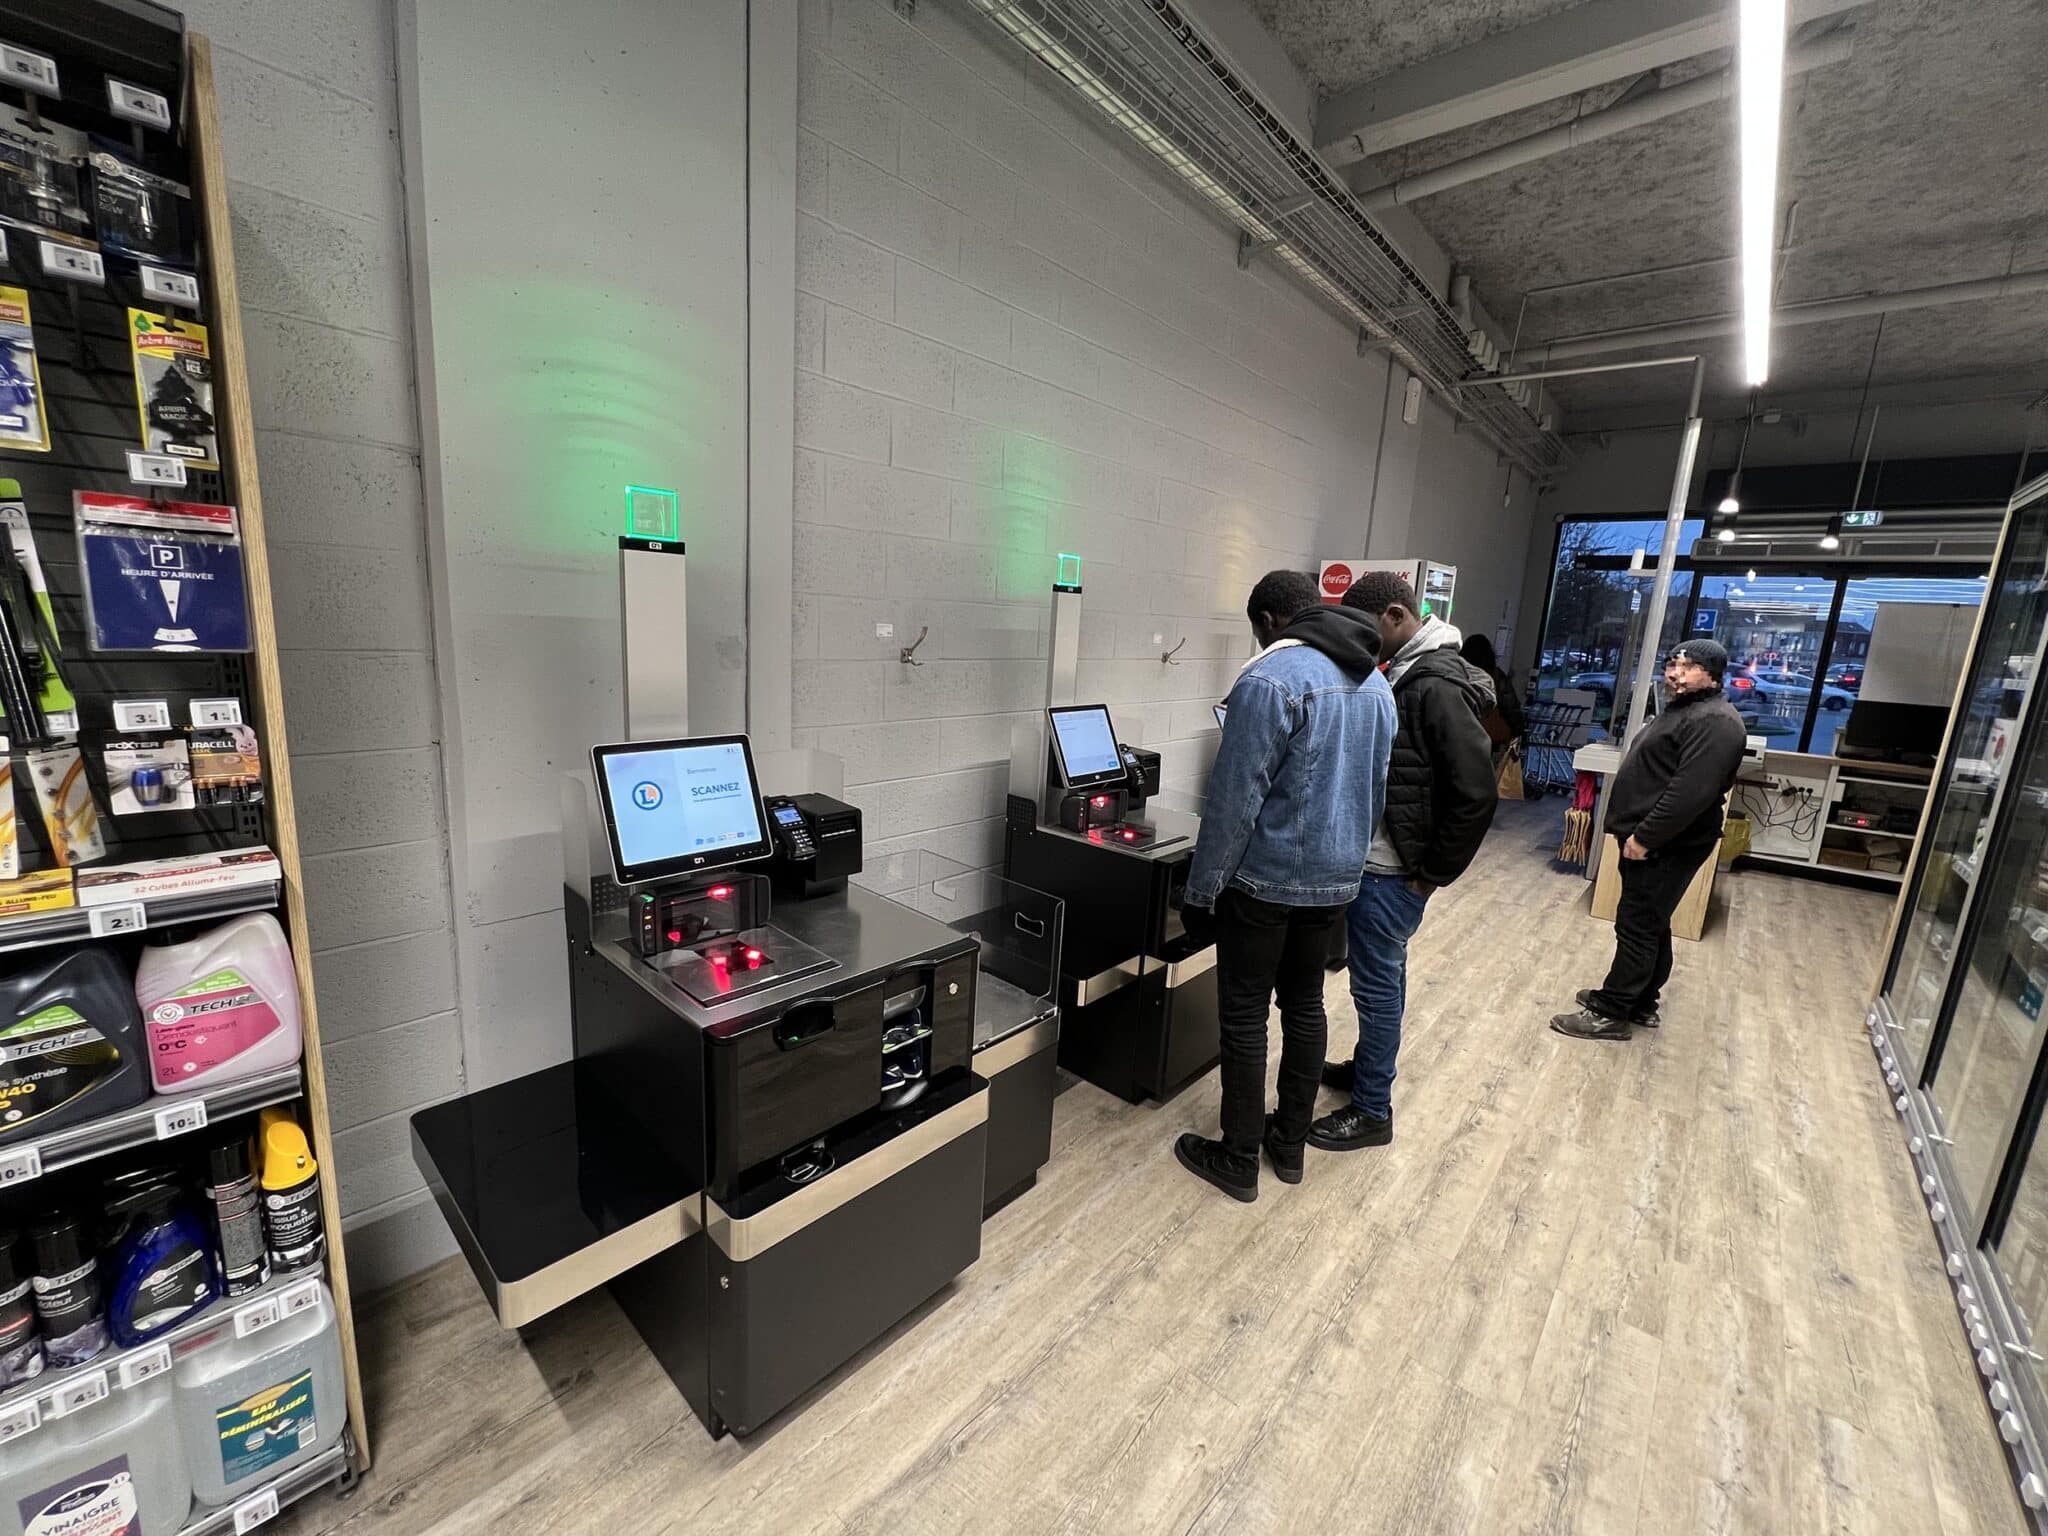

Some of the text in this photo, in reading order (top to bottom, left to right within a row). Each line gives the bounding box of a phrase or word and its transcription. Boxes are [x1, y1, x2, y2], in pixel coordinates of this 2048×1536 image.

[159, 549, 175, 564] P
[121, 568, 158, 578] HEURE
[1323, 573, 1351, 584] Coca-Cola
[135, 714, 147, 724] 3
[209, 712, 220, 721] 1
[105, 740, 160, 750] FOXTER
[188, 740, 235, 750] URACELL
[691, 781, 741, 796] SCANNEZ
[149, 881, 179, 893] Cubes
[180, 873, 237, 888] Allume-feu
[111, 917, 123, 929] 2
[12, 1066, 68, 1086] synthèse
[162, 1066, 177, 1077] 2L
[168, 1117, 186, 1130] 10
[250, 1400, 278, 1418] EAU
[41, 1496, 121, 1536] VINAIGRE
